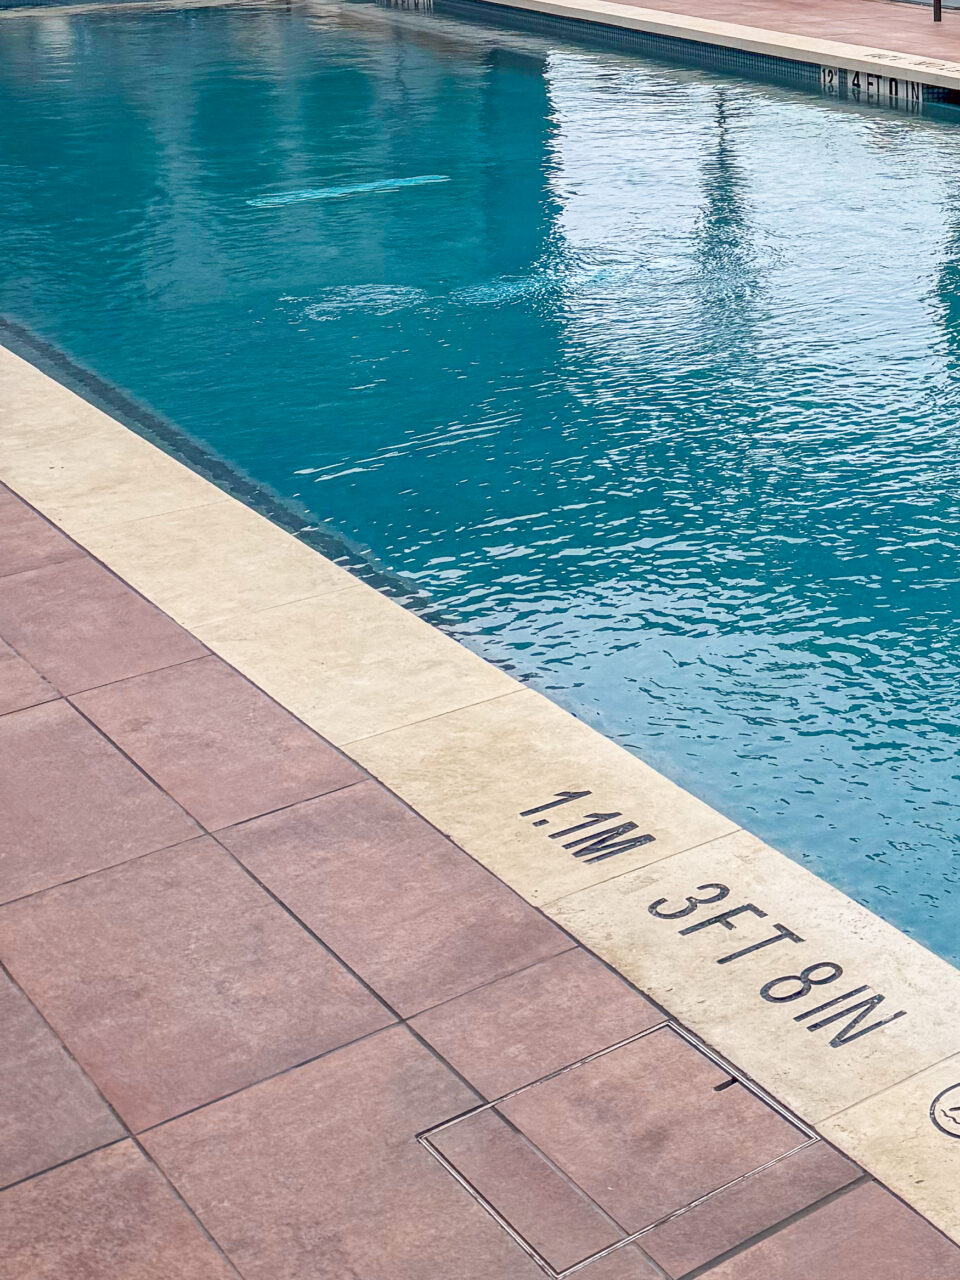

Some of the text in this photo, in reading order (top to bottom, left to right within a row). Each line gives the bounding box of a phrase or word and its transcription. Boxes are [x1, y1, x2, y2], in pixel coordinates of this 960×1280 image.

[852, 71, 861, 88] 4
[867, 73, 882, 94] FT
[905, 80, 919, 101] IN
[519, 790, 656, 865] 1.1M
